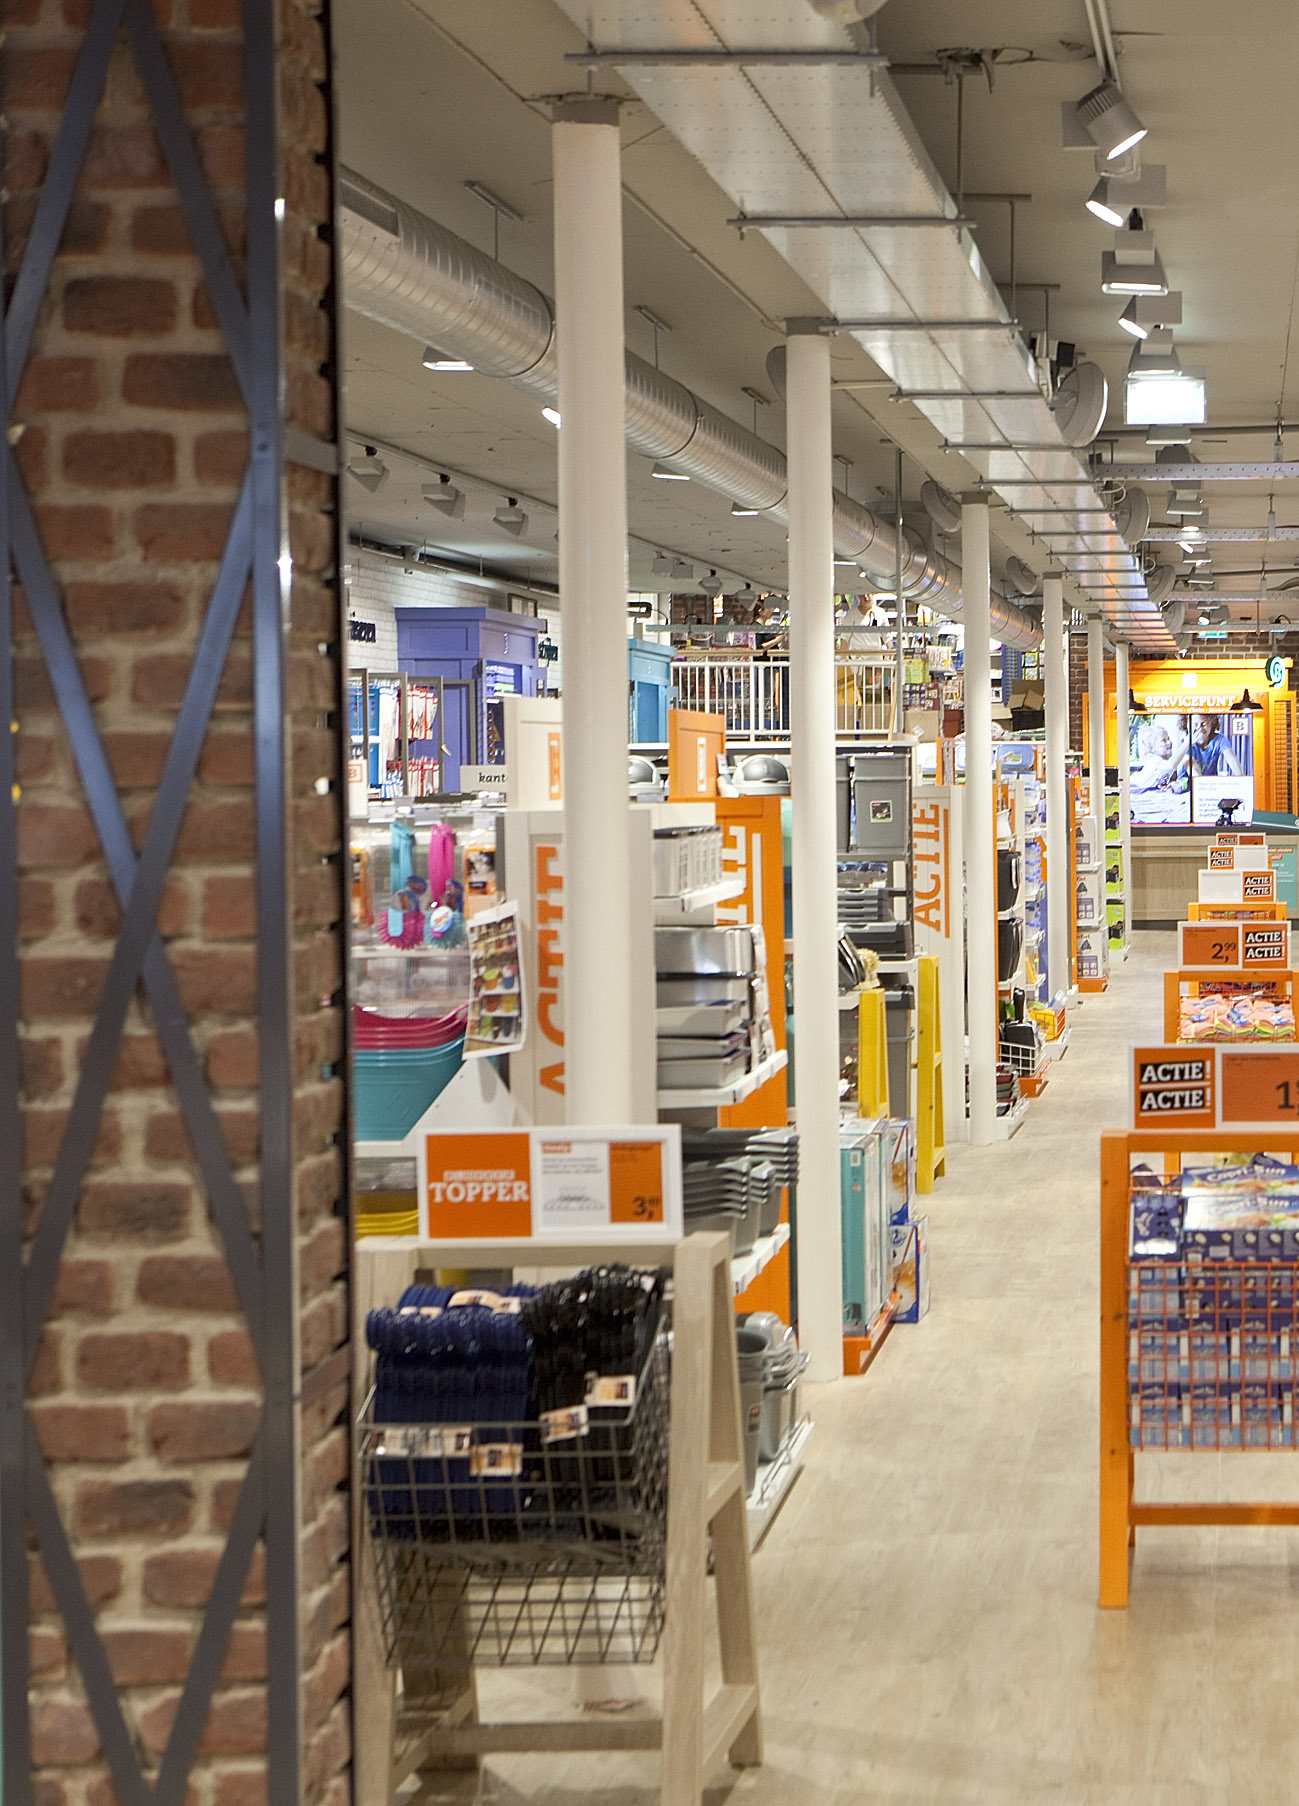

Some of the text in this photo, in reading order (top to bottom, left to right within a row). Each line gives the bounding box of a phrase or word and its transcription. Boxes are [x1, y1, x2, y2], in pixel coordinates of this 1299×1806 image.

[1144, 695, 1235, 708] SERVICEPUNT
[1245, 876, 1272, 885] ACTIE!
[1245, 886, 1272, 896] ACTIE!
[1246, 930, 1286, 943] ACTIE!
[1211, 942, 1237, 963] 2,99
[1246, 945, 1286, 959] ACTIE!
[1140, 1060, 1211, 1083] ACTIE!
[1141, 1087, 1211, 1111] ACTIE!
[428, 1180, 530, 1204] TOPPER
